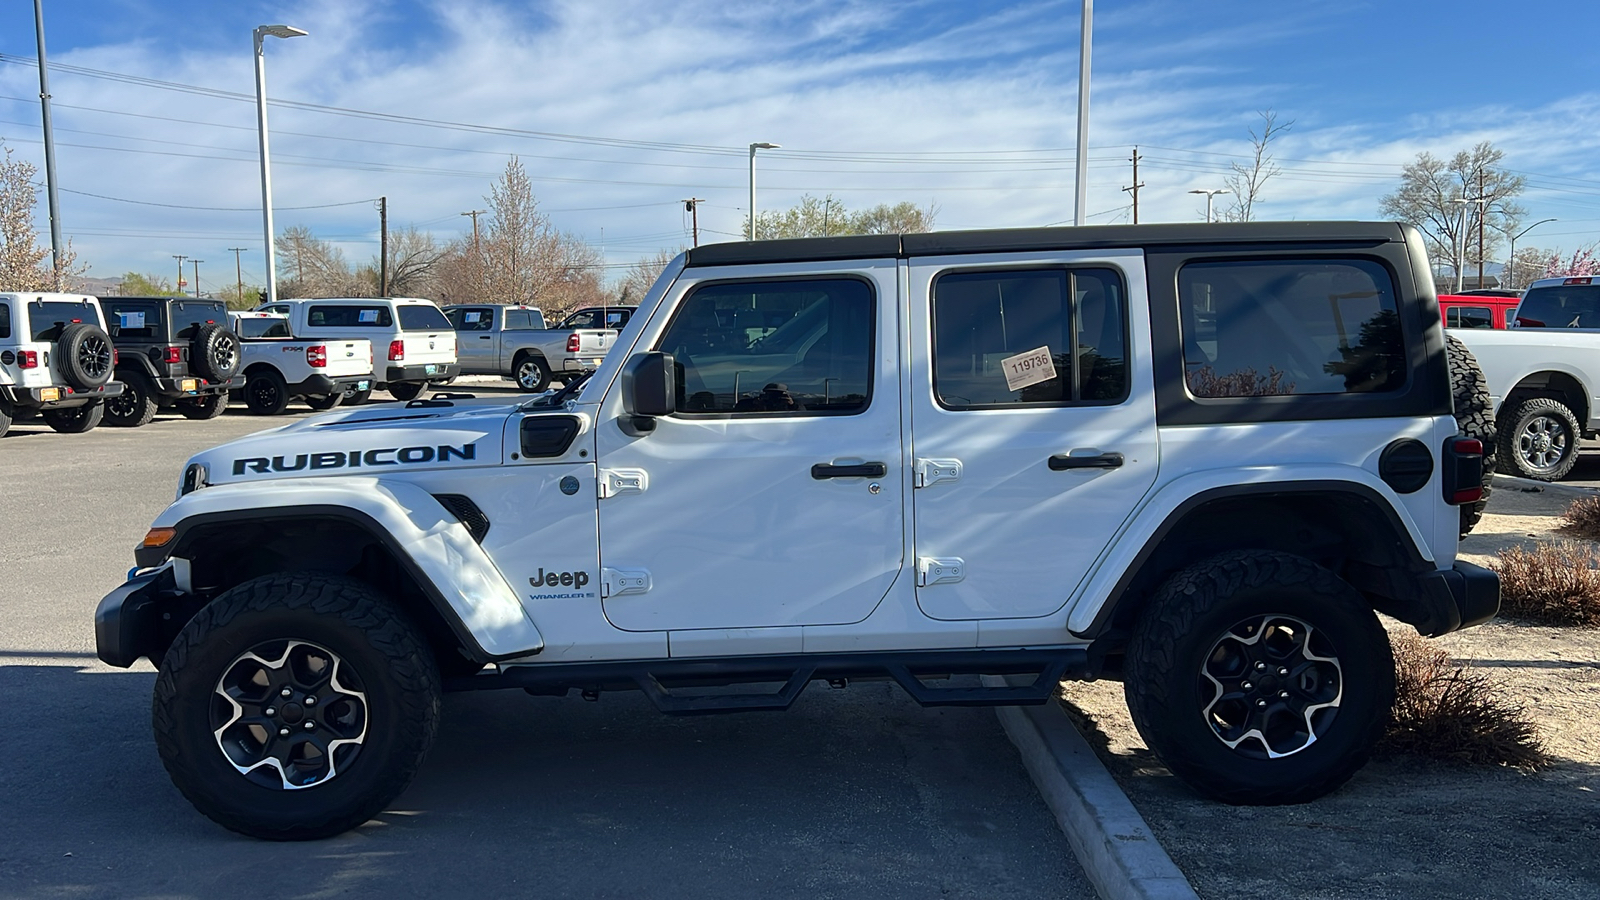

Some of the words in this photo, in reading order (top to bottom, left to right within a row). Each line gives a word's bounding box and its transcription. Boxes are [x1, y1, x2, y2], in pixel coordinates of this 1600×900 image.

[1012, 354, 1048, 373] 119736
[232, 444, 476, 476] RUBICON
[529, 568, 588, 589] Jeep
